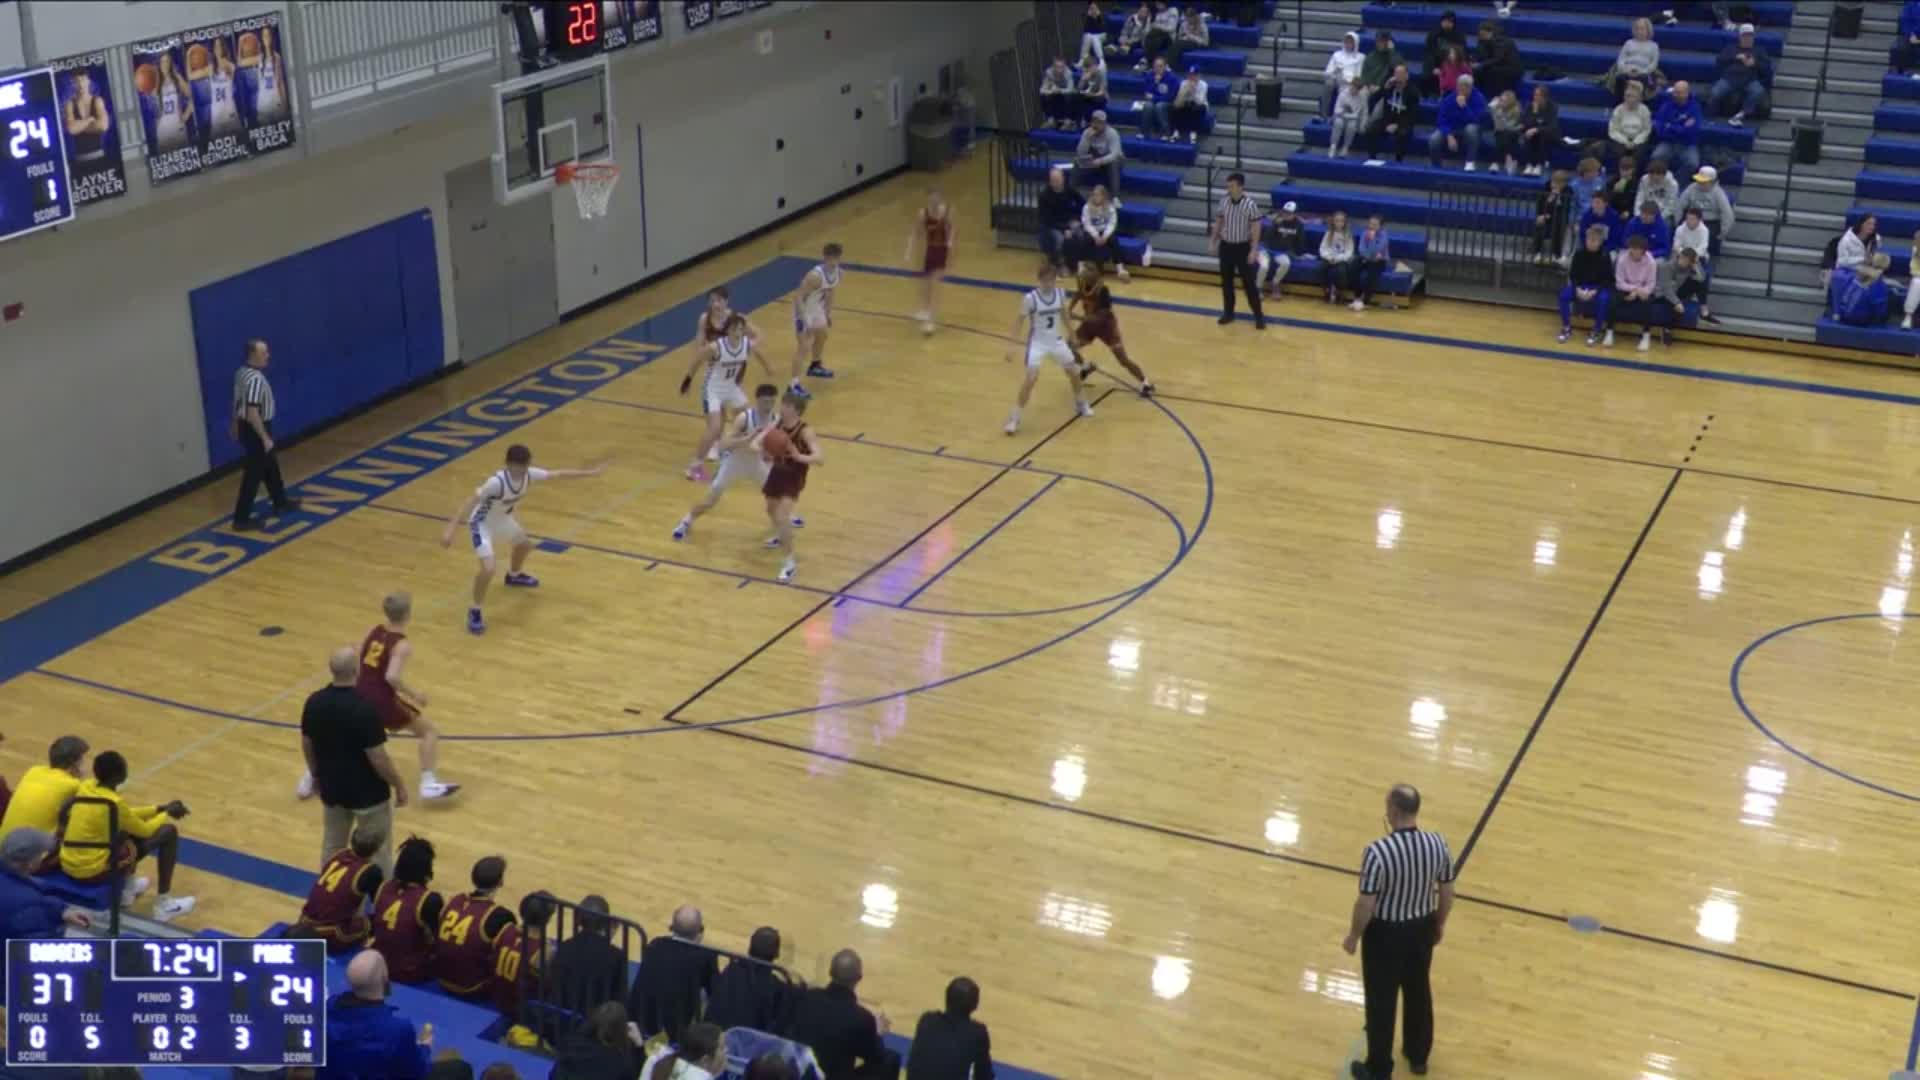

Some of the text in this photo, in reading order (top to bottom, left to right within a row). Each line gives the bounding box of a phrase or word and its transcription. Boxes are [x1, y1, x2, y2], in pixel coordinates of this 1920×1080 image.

[568, 2, 597, 45] 22
[9, 116, 51, 159] 24
[207, 135, 237, 152] ADDI
[256, 134, 288, 151] BACA
[26, 160, 56, 178] FOULS
[150, 145, 199, 170] ELIZABETH
[72, 179, 124, 203] BOEVER
[73, 168, 117, 190] LAYNE
[319, 860, 349, 892] 14
[383, 899, 403, 930] 4
[438, 910, 474, 945] 24
[495, 945, 522, 982] 10
